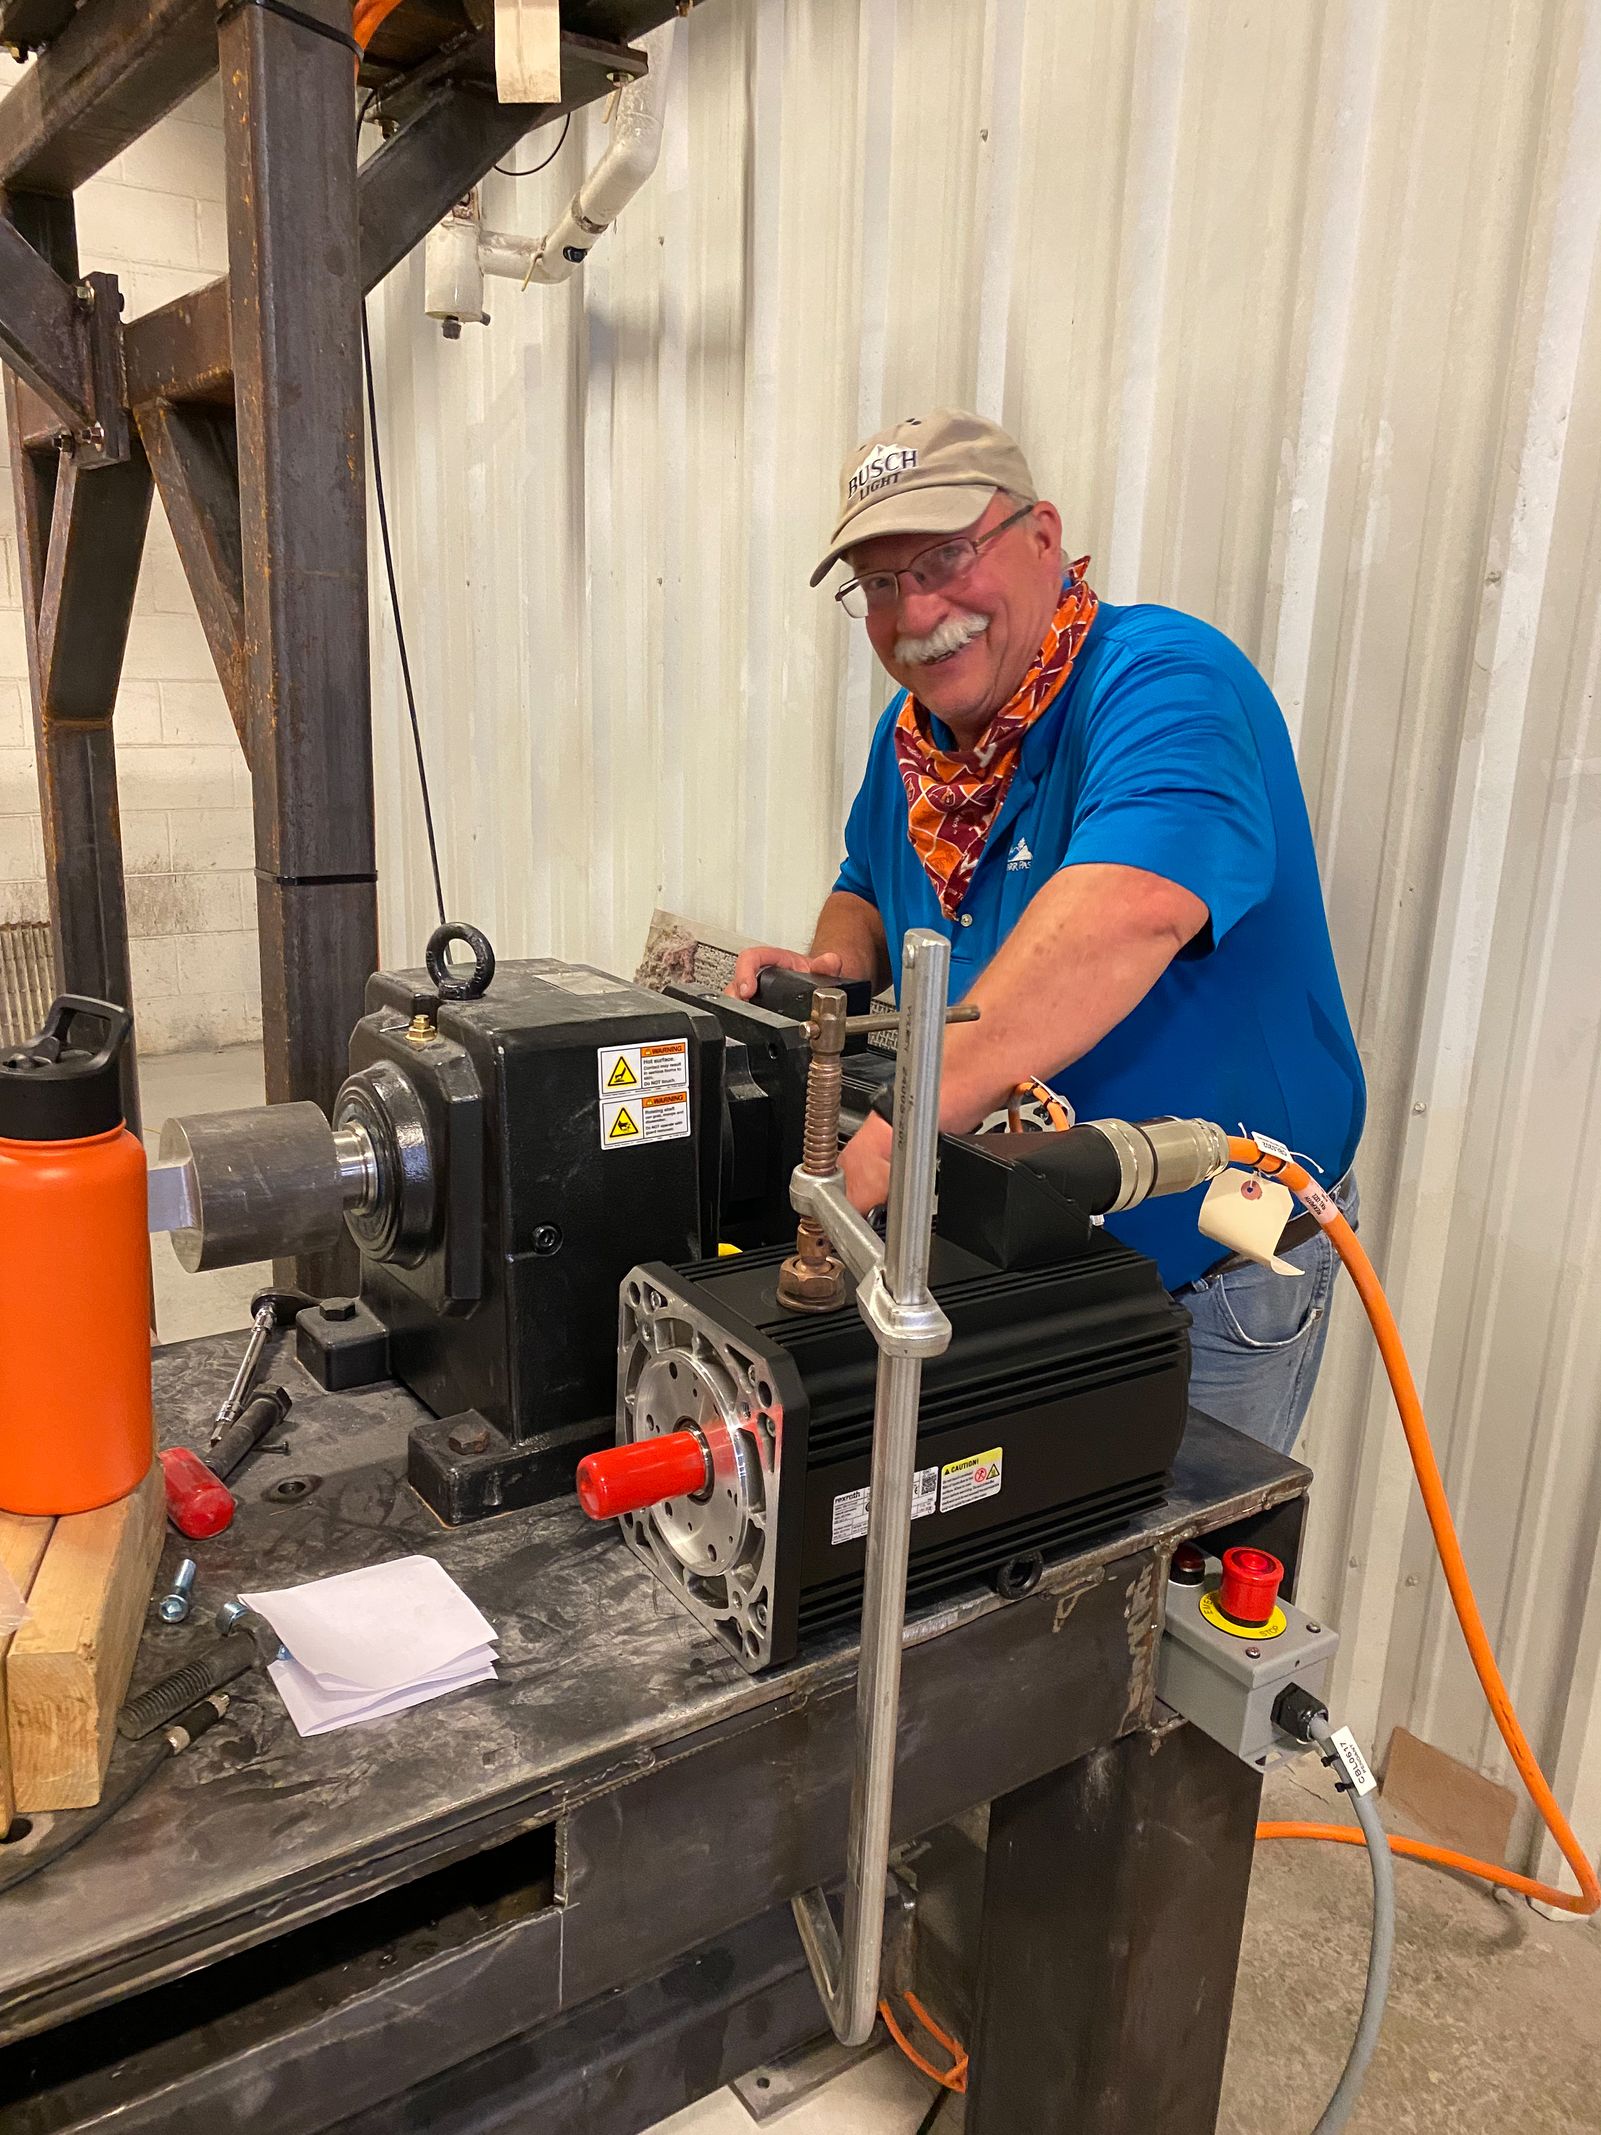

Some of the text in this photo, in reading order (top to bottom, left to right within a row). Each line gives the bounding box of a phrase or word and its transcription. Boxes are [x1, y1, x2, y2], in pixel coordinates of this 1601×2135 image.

[848, 450, 917, 499] BUSCH
[860, 472, 901, 501] LIGHT
[652, 1046, 682, 1055] WARNING
[653, 1095, 684, 1104] WARNING
[951, 1458, 979, 1473] CAUTION!
[835, 1491, 861, 1503] rexroth
[1259, 1625, 1279, 1637] STOP
[1339, 1742, 1365, 1784] CBL0617
